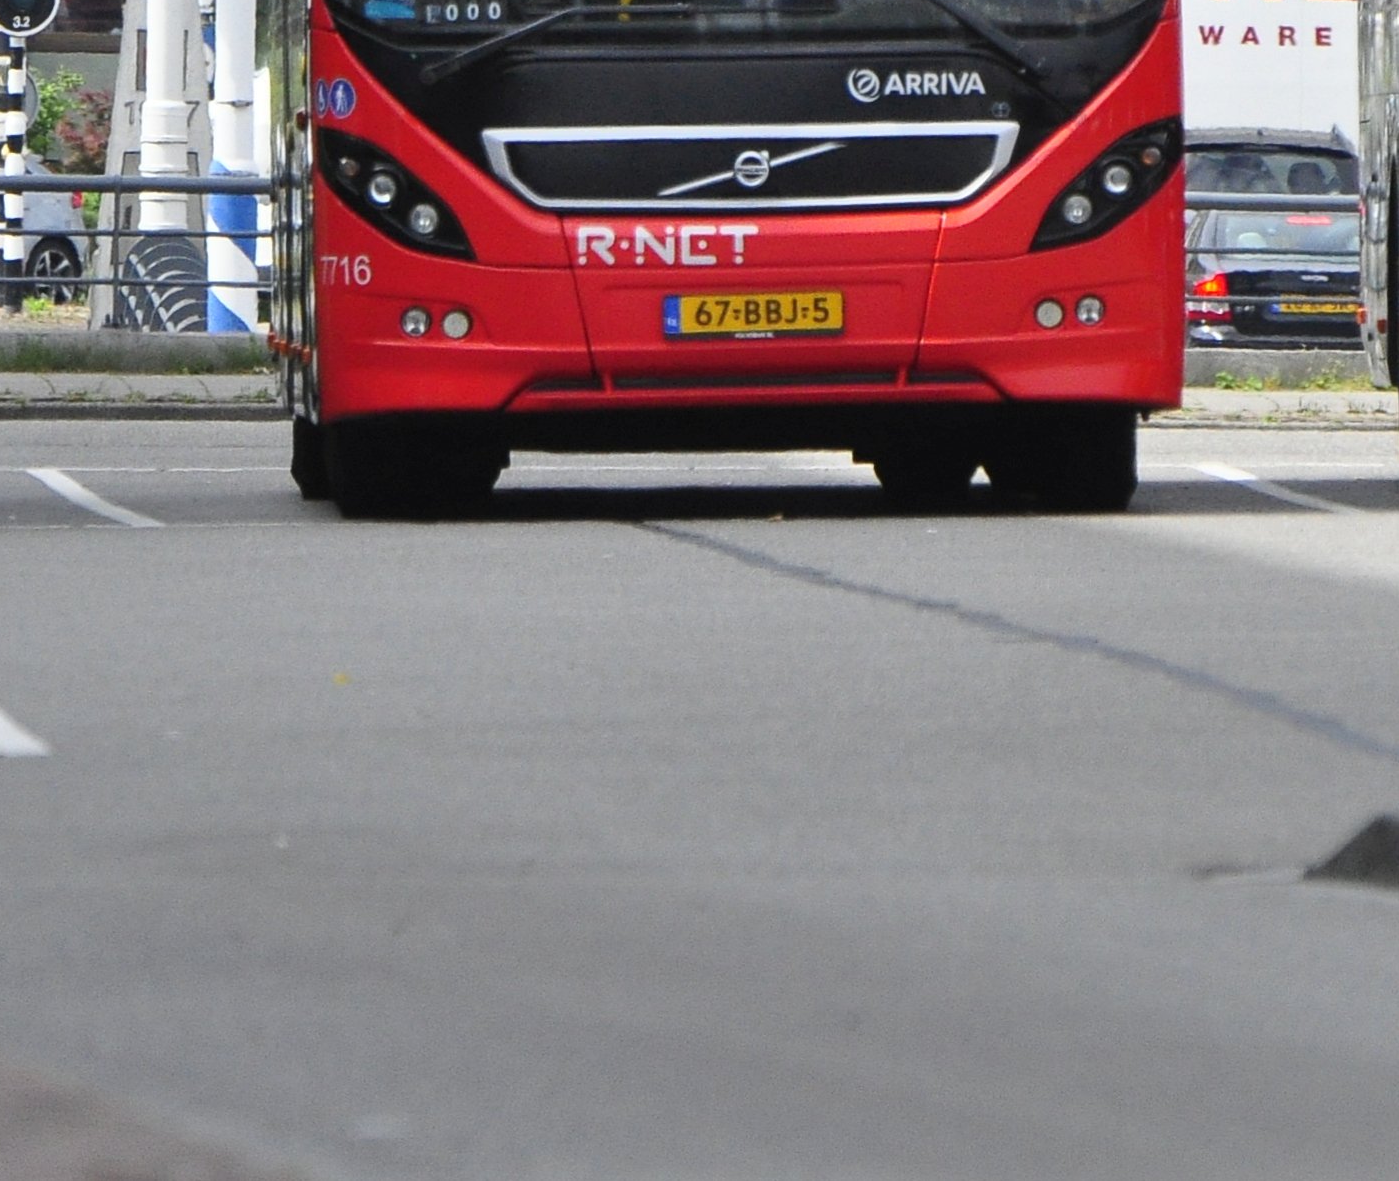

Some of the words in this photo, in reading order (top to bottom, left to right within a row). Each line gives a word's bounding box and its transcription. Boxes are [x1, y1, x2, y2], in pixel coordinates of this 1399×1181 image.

[12, 15, 31, 29] 3.2
[1198, 24, 1333, 47] WARE
[884, 71, 986, 96] ARRIVA
[694, 296, 831, 327] 67-BBJ-5
